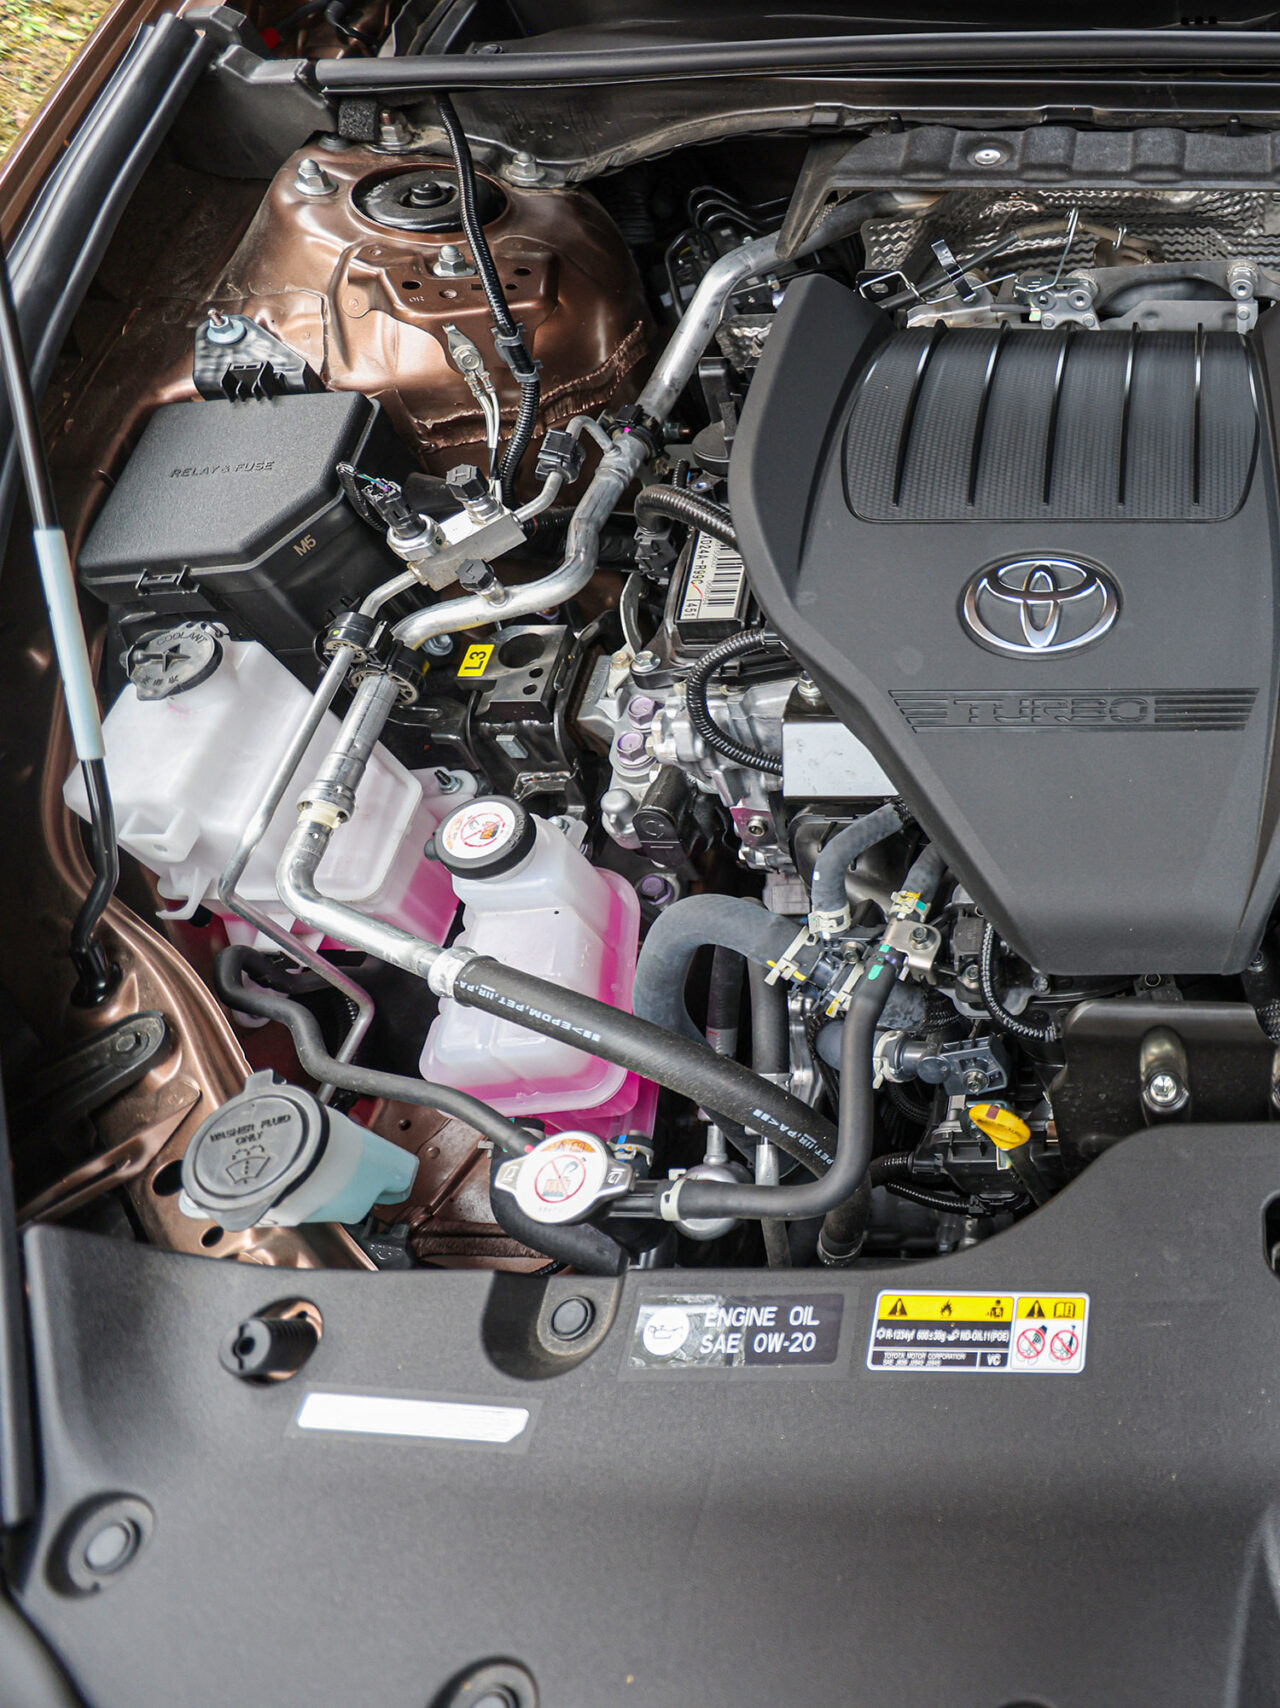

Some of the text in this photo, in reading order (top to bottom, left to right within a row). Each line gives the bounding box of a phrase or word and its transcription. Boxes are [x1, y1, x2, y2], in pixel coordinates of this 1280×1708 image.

[170, 465, 219, 479] RELAY
[234, 459, 275, 473] FUSE
[293, 535, 318, 558] M5
[156, 631, 208, 647] COOLANT
[463, 650, 485, 672] L3
[953, 697, 1149, 724] TURBO
[211, 1113, 292, 1142] WASHER FLUID
[235, 1130, 264, 1145] ONLY
[704, 1305, 820, 1327] ENGINE OIL
[700, 1332, 817, 1354] SAE 0W-20
[884, 1352, 967, 1361] TOYOTA MOTOR CORPORATION
[987, 1354, 1001, 1366] VC
